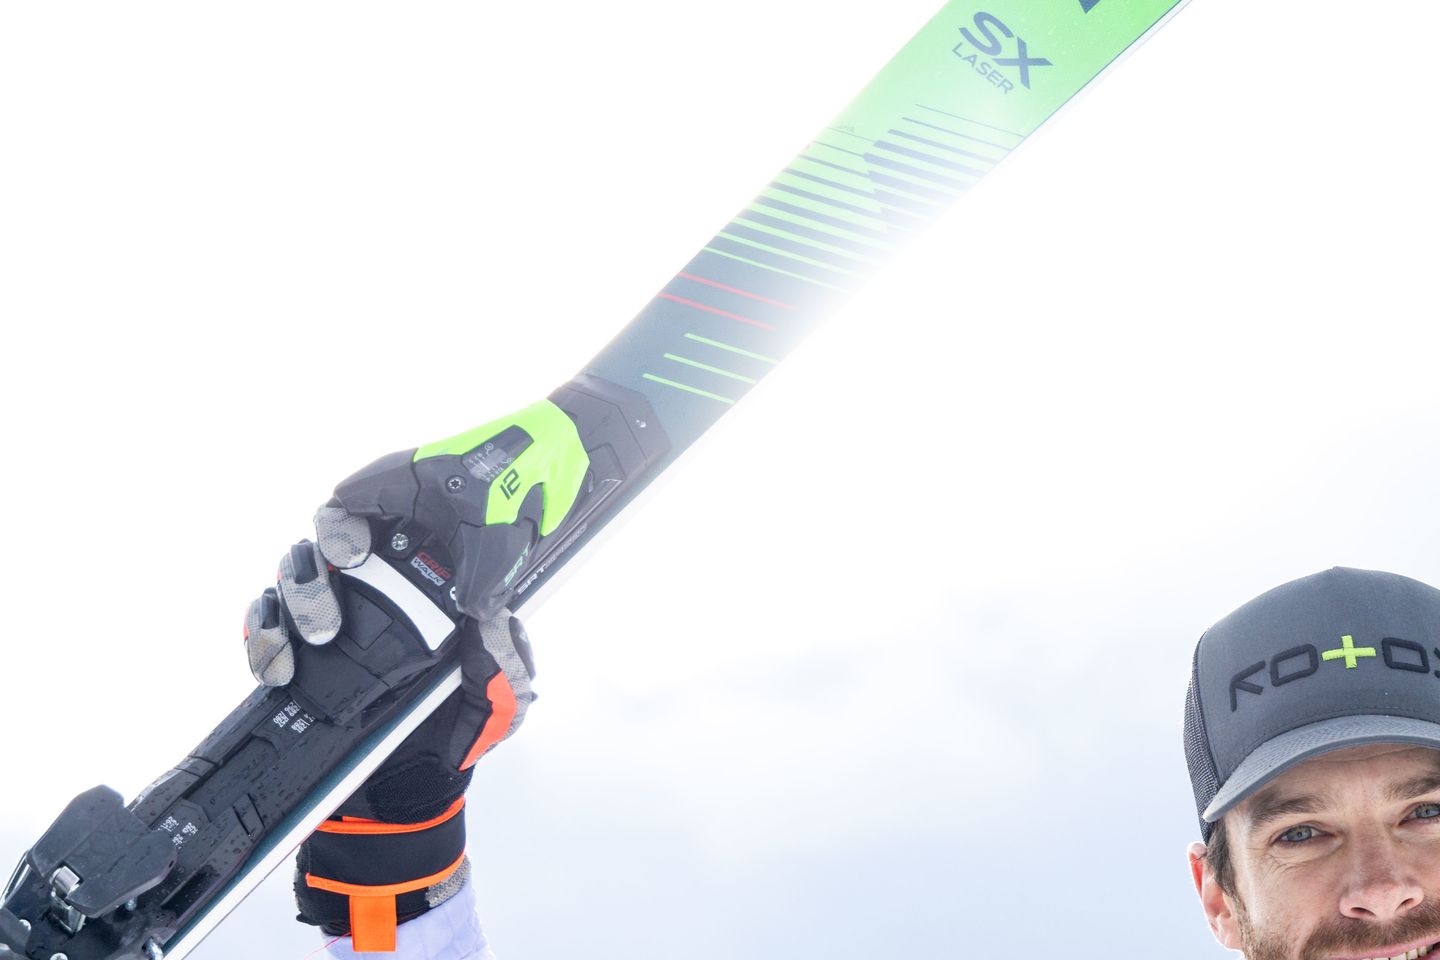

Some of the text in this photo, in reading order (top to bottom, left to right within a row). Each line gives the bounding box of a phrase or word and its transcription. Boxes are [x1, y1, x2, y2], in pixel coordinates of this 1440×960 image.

[951, 42, 1014, 94] LASER
[958, 11, 1054, 90] SX
[500, 468, 520, 501] 12
[411, 557, 446, 586] WALK
